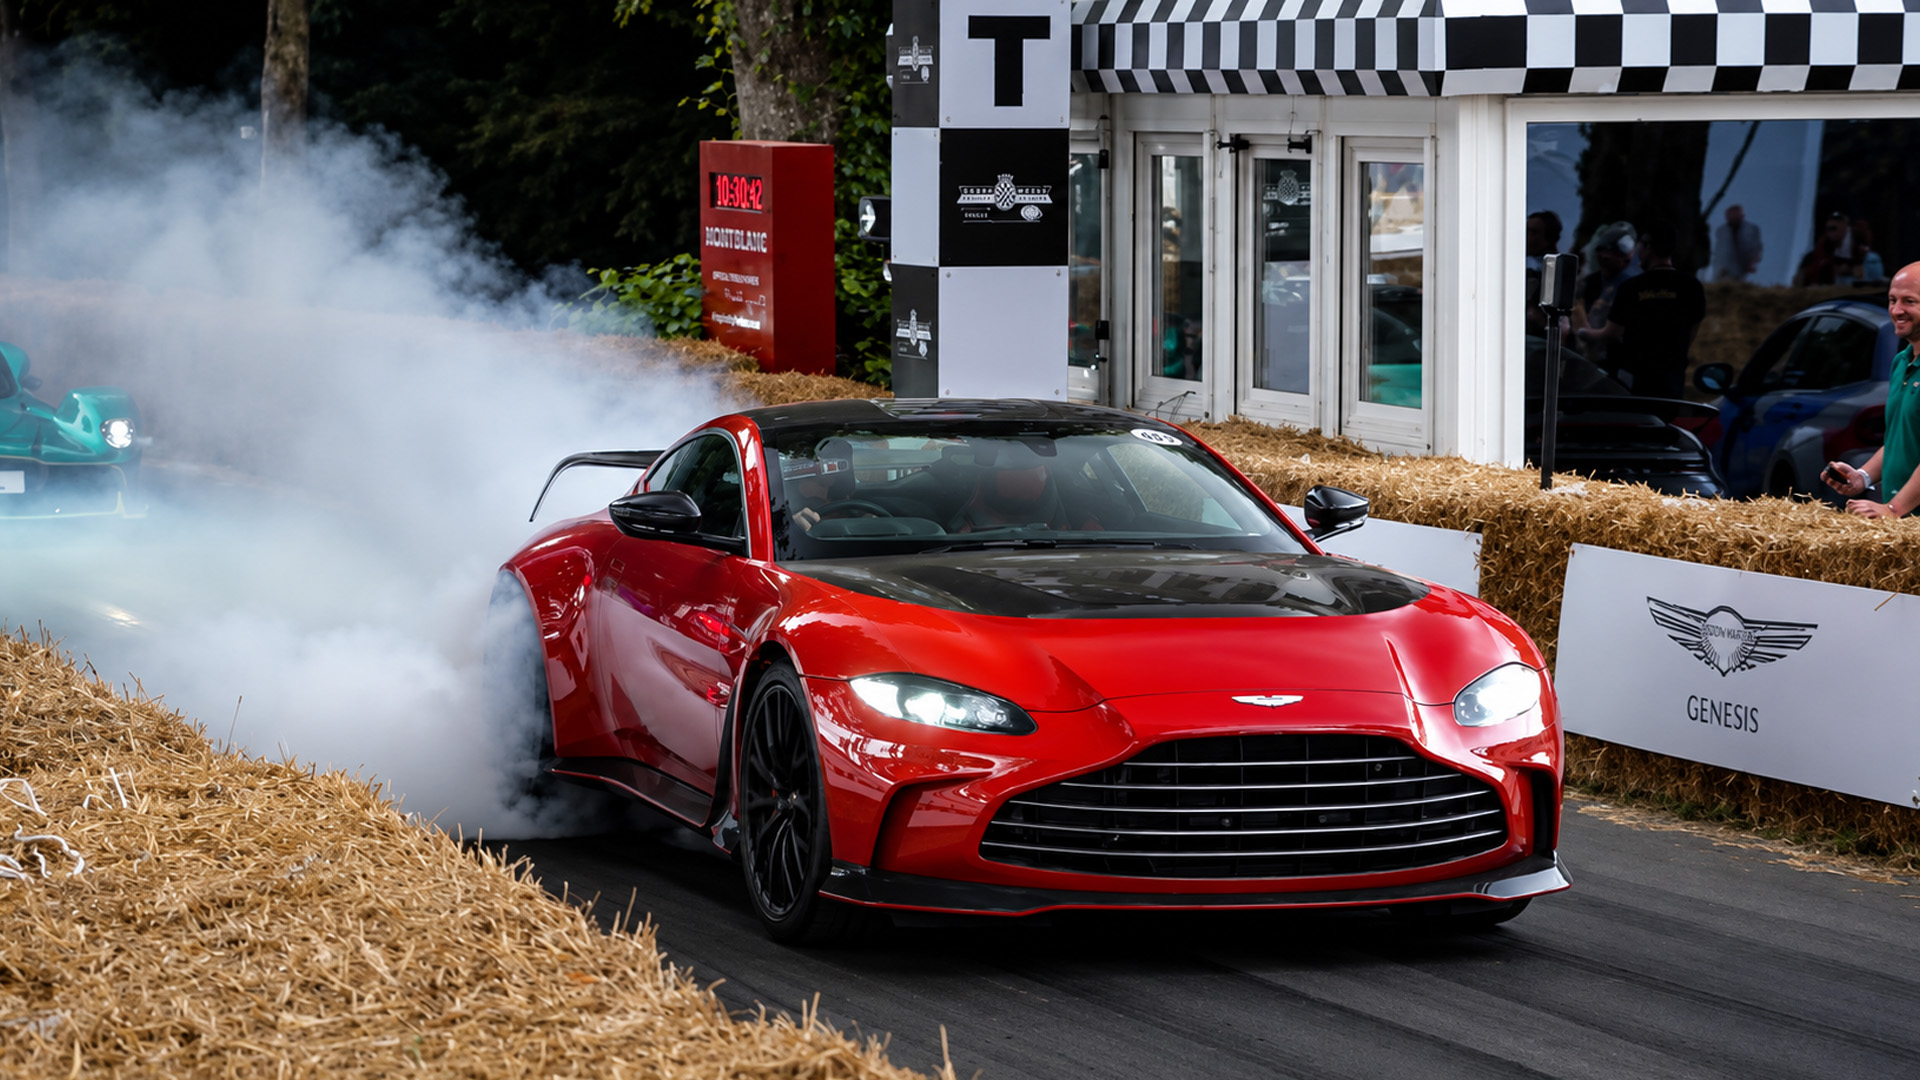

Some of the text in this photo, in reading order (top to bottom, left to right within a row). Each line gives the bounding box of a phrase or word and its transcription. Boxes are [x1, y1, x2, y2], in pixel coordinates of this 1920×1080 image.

[968, 15, 1051, 107] T
[705, 226, 767, 253] MONTBLANC
[1687, 695, 1759, 734] GENESIS
